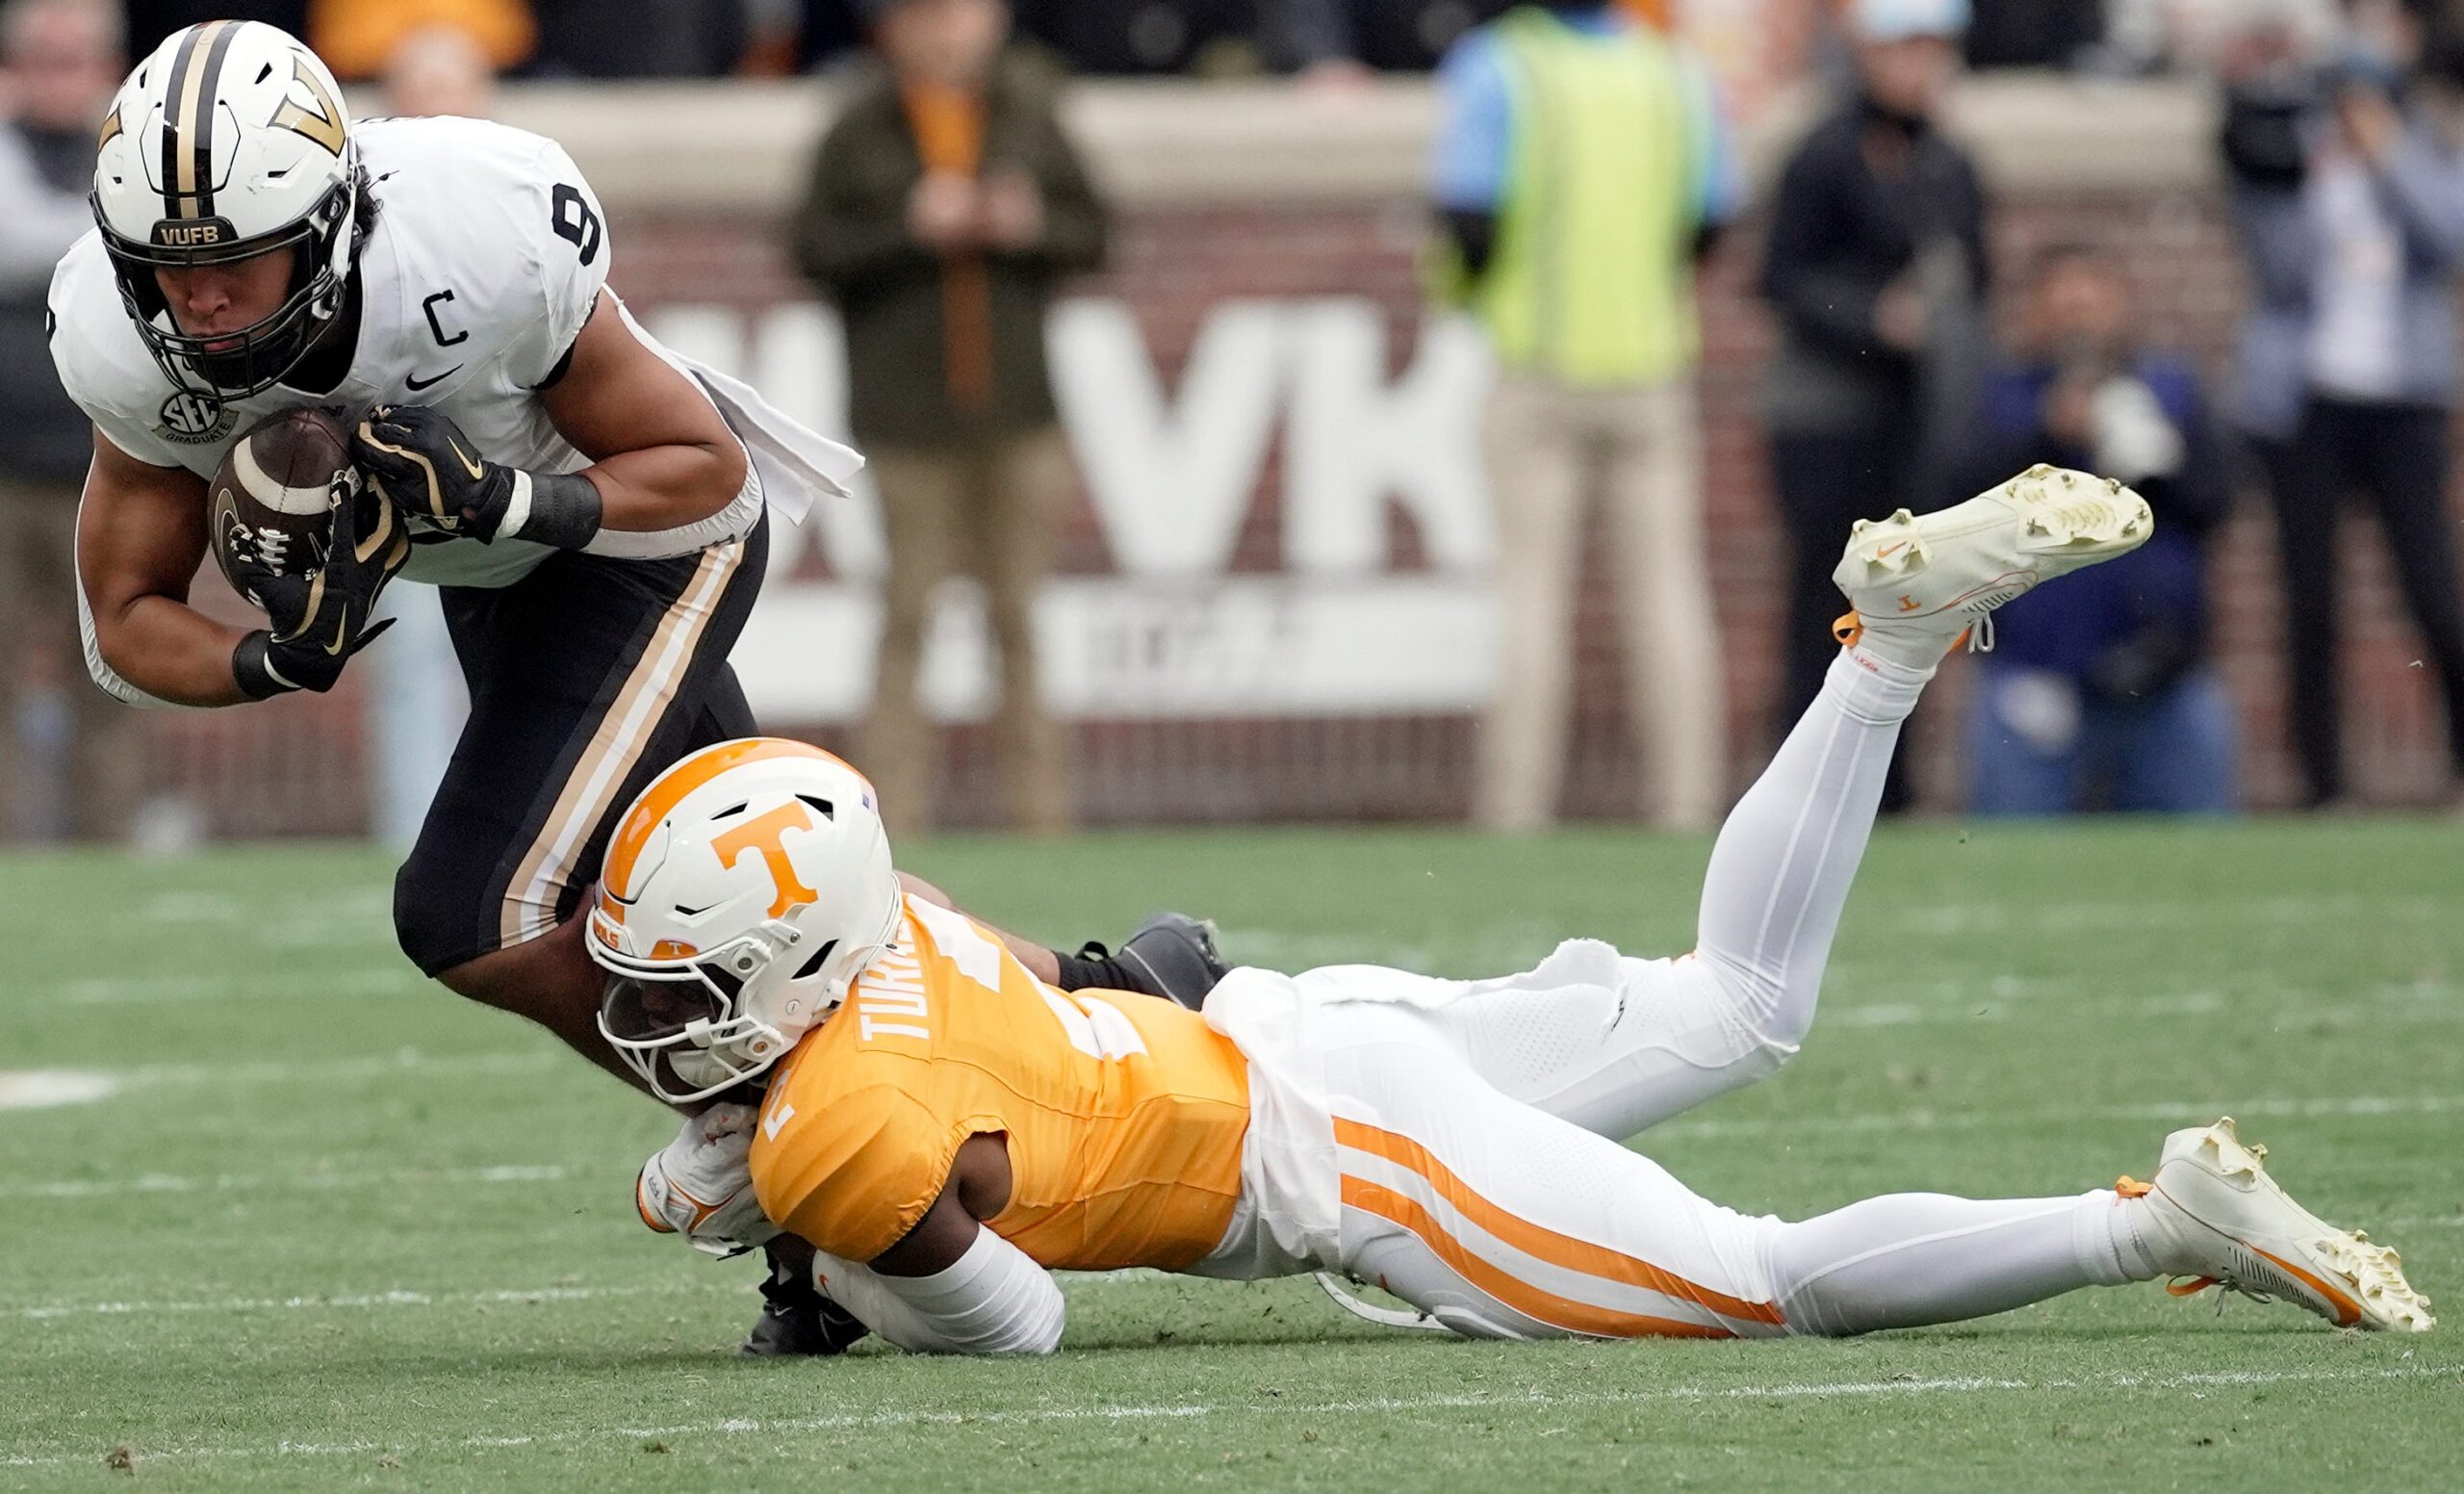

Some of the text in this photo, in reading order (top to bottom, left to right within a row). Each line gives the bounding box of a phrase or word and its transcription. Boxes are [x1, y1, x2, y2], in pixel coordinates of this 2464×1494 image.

[268, 56, 346, 158] V
[161, 226, 218, 245] VUFB
[552, 183, 601, 267] 9
[423, 289, 469, 347] C
[163, 393, 218, 433] SEC
[165, 422, 231, 445] GRADUATE
[710, 800, 818, 919] T
